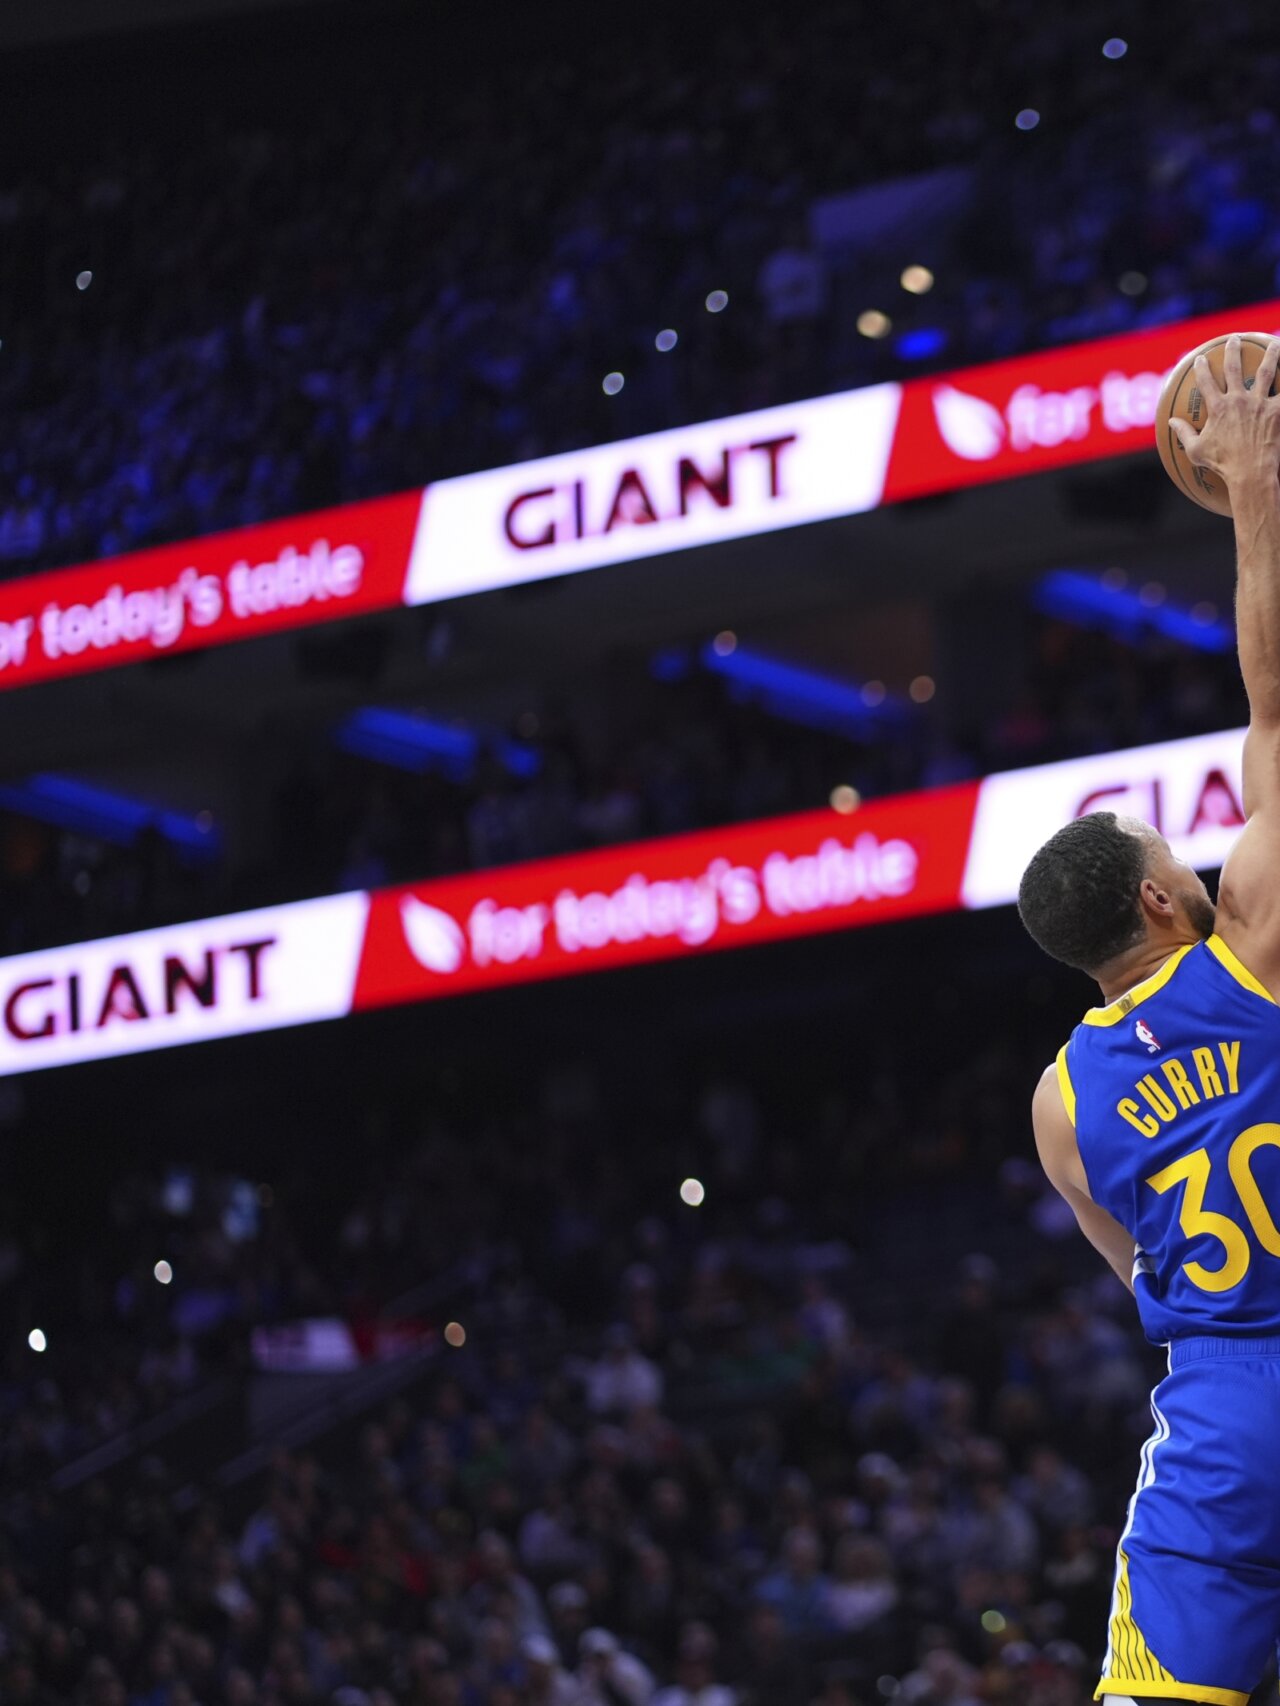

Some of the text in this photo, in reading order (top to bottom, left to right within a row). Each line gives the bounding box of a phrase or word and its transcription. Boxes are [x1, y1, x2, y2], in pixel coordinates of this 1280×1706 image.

[1007, 384, 1096, 452] for
[504, 434, 796, 549] GIANT
[40, 566, 223, 659] today's
[227, 538, 364, 618] table
[470, 831, 918, 967] for today's table
[4, 937, 276, 1040] GIANT
[1117, 1041, 1241, 1139] CURRY
